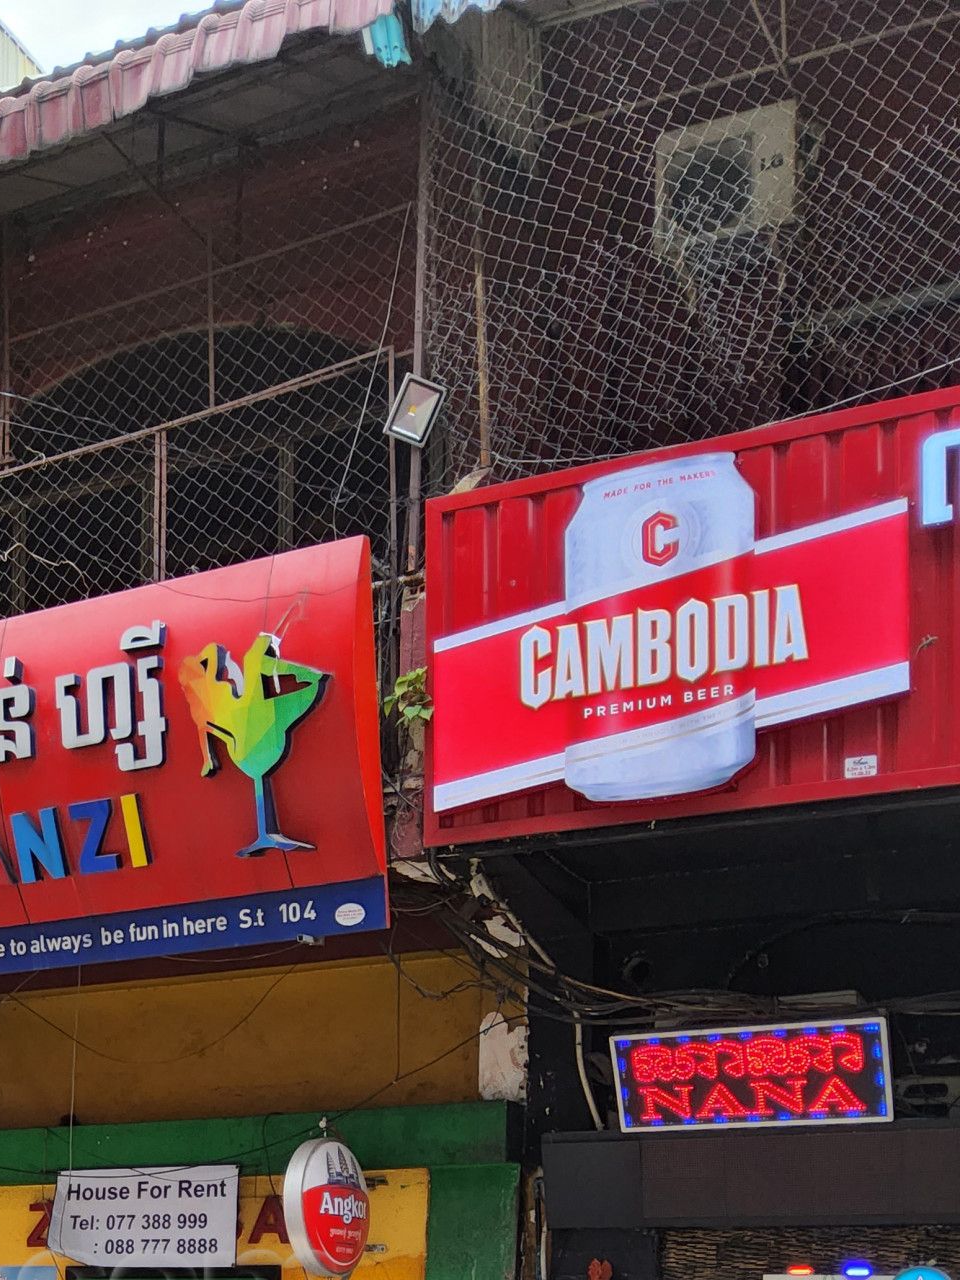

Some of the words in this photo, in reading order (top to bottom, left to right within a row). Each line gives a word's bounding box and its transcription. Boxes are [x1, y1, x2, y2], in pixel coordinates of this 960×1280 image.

[603, 487, 628, 500] MADE
[634, 482, 651, 491] FOR
[657, 478, 673, 487] THE
[680, 470, 716, 481] MAKERS
[642, 511, 679, 567] C
[520, 584, 809, 711] CAMBODIA
[583, 694, 672, 719] PREMIUM
[683, 684, 734, 703] BEER
[10, 939, 27, 957] to
[30, 933, 93, 954] always
[100, 927, 124, 946] be
[129, 923, 159, 942] fun
[163, 918, 181, 938] in
[183, 915, 228, 936] here
[279, 900, 317, 923] 104
[637, 1075, 868, 1121] NANA
[67, 1182, 130, 1201] House
[137, 1181, 172, 1200] For
[178, 1179, 227, 1199] Rent
[70, 1215, 100, 1231] Tel:
[106, 1214, 136, 1230] 077
[141, 1214, 172, 1230] 388
[177, 1213, 208, 1230] 999
[319, 1191, 368, 1225] Angkor
[104, 1239, 135, 1255] 088
[140, 1239, 171, 1255] 777
[176, 1238, 219, 1255] 8888
